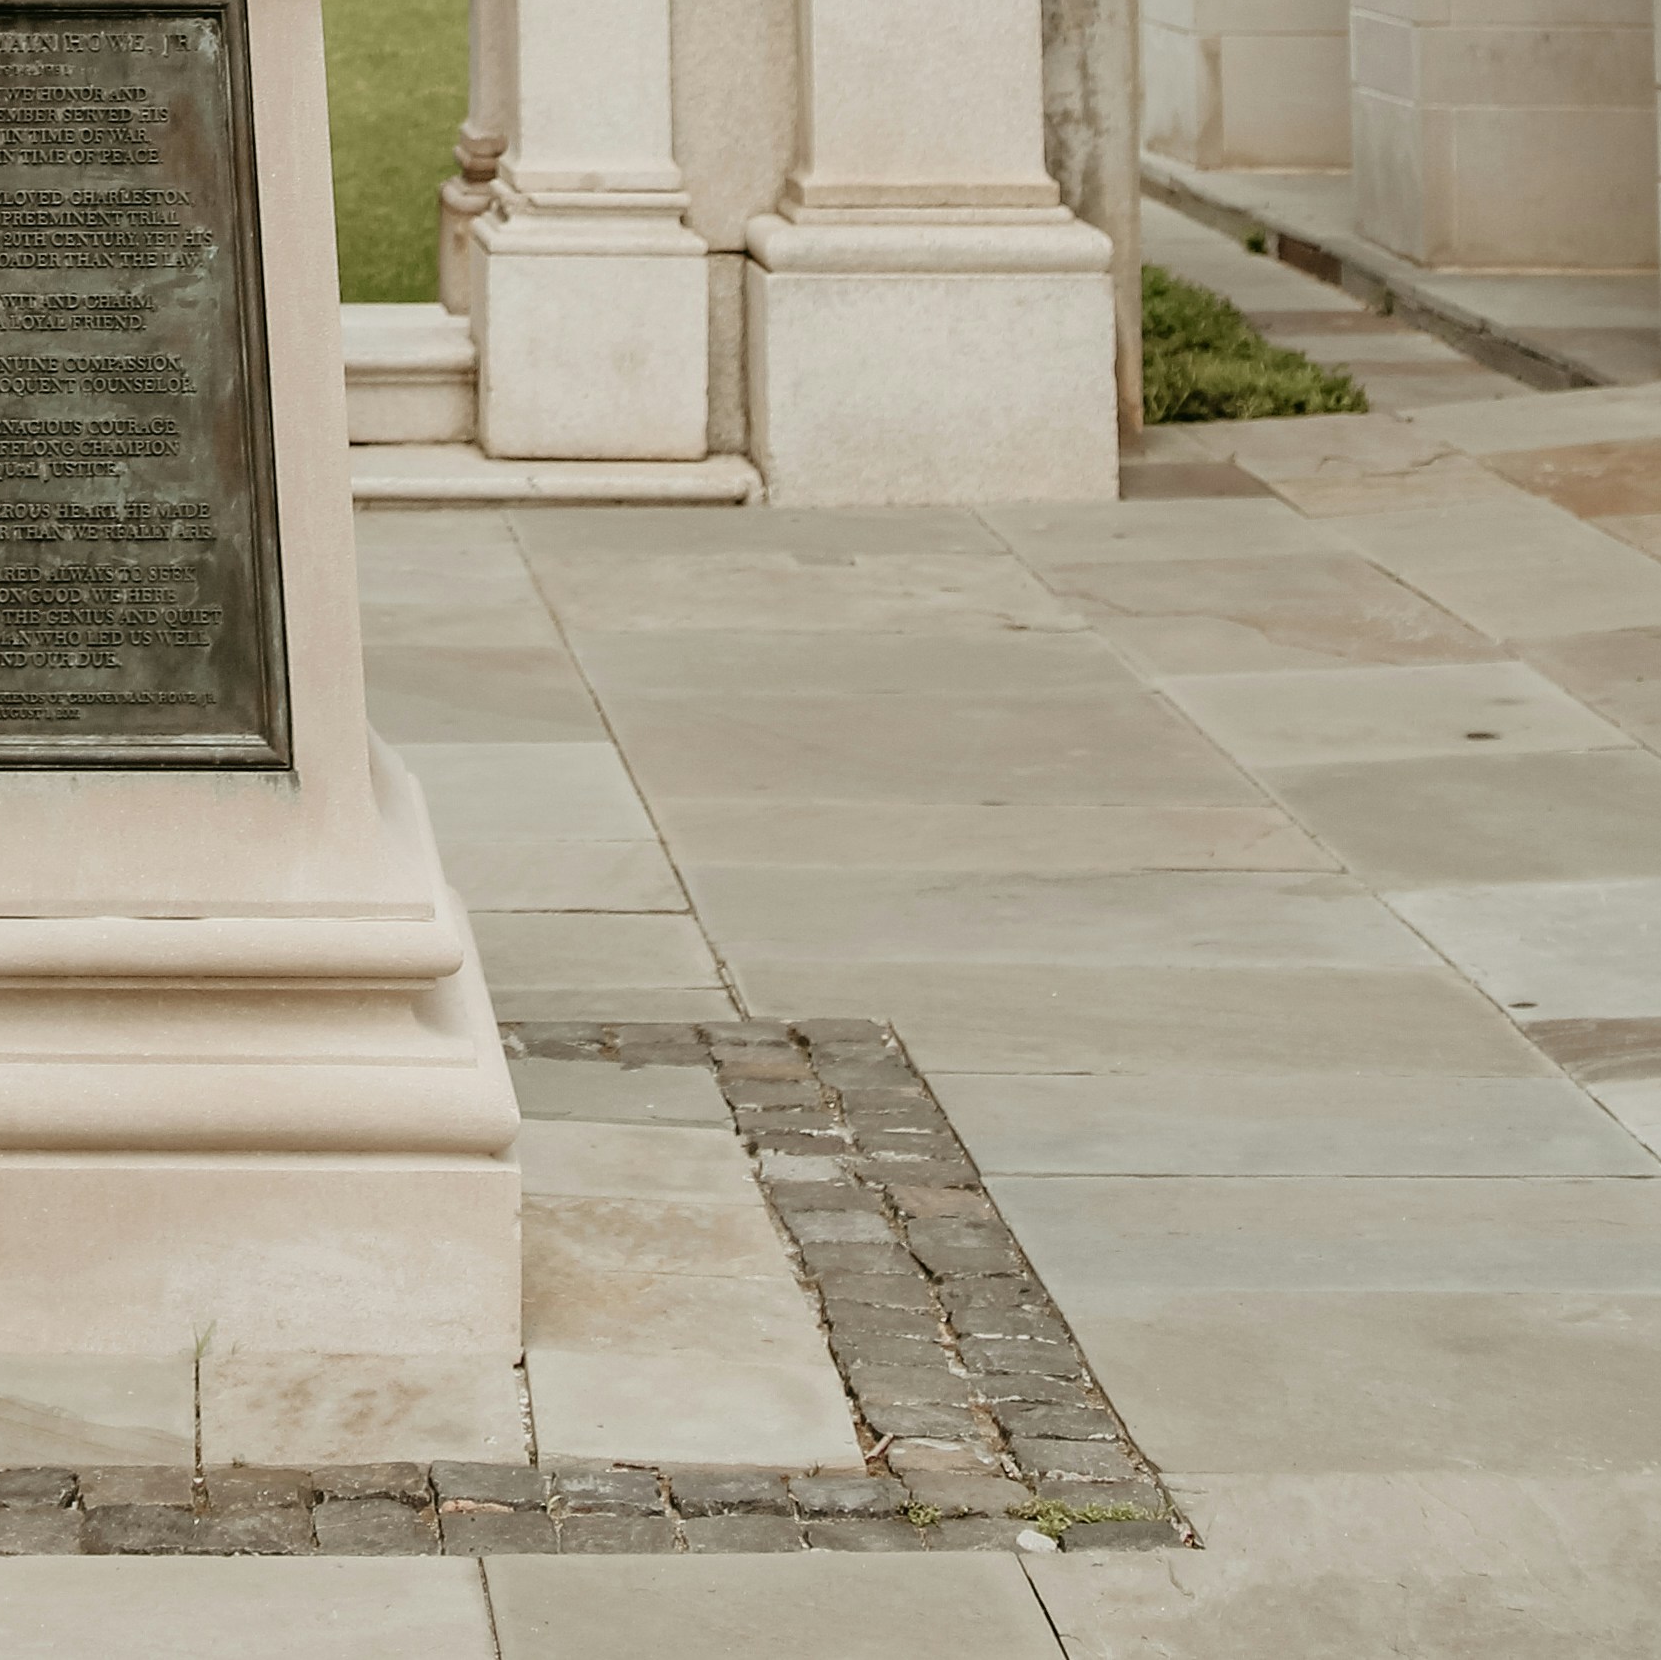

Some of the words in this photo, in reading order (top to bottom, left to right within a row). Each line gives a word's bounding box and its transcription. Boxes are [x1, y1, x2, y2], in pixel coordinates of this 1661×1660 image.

[64, 33, 153, 54] HOWE,
[162, 33, 199, 58] JR.
[5, 86, 32, 103] WE
[36, 86, 105, 102] HONOR
[108, 86, 148, 102] AND
[62, 107, 133, 123] SERVED
[138, 107, 169, 123] HIS
[2, 128, 24, 145] IN
[27, 128, 75, 144] TIME
[80, 128, 105, 144] OF
[19, 149, 66, 165] TIME
[69, 149, 96, 165] OF
[99, 149, 164, 165] PEACE.
[69, 189, 196, 207] CHARLESTON,
[0, 211, 124, 227] PREEMINENT
[126, 211, 181, 227] TRIAL
[4, 232, 47, 248] 20TH
[144, 231, 178, 247] YET
[181, 231, 214, 247] HIS
[63, 252, 116, 269] THAN
[119, 252, 158, 269] THE
[0, 293, 38, 310] WIT
[42, 294, 80, 310] AND
[83, 294, 157, 312] CHARM,
[8, 314, 67, 331] LOYAL
[69, 314, 148, 331] FRIEND.
[62, 356, 187, 375] COMPASSION,
[80, 377, 198, 394] COUNSELOR.
[79, 440, 180, 457] CHAMPION
[124, 503, 151, 519] HE
[153, 503, 212, 519] MADE
[12, 524, 65, 541] THAN
[71, 524, 98, 541] WE
[104, 524, 170, 541] REALLY
[46, 566, 115, 583] ALWAYS
[117, 566, 143, 582] TO
[147, 566, 197, 582] SEEK
[90, 587, 122, 604] WE
[126, 587, 178, 604] HERE
[2, 609, 41, 626] THE
[46, 609, 115, 625] GENIUS
[118, 609, 160, 625] AND
[164, 609, 223, 627] QUIET
[33, 630, 81, 646] WHO
[85, 630, 125, 646] LED
[129, 630, 153, 646] US
[32, 651, 74, 668] OUR
[76, 651, 123, 668] DUE.
[49, 692, 65, 705] OF
[69, 691, 120, 705] GEDNEY
[122, 691, 154, 705] MAIN
